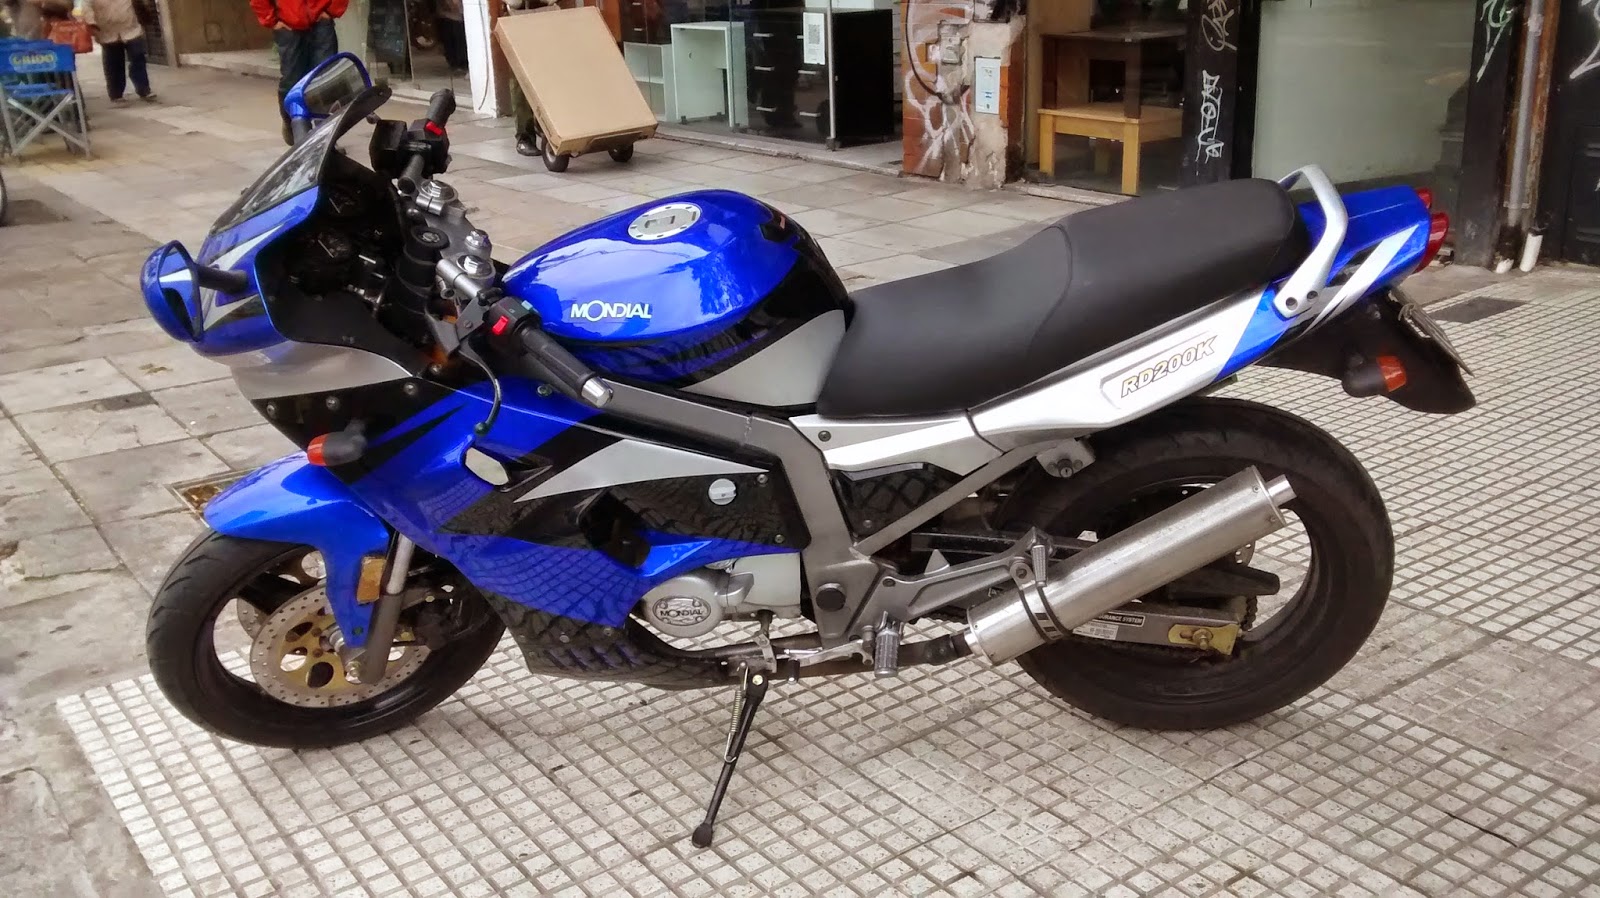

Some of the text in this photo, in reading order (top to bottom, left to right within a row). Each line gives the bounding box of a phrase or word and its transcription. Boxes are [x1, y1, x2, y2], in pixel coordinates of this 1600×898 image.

[570, 300, 652, 321] MONDIAL
[1120, 335, 1218, 399] RD200K
[660, 609, 703, 618] MONDIAL
